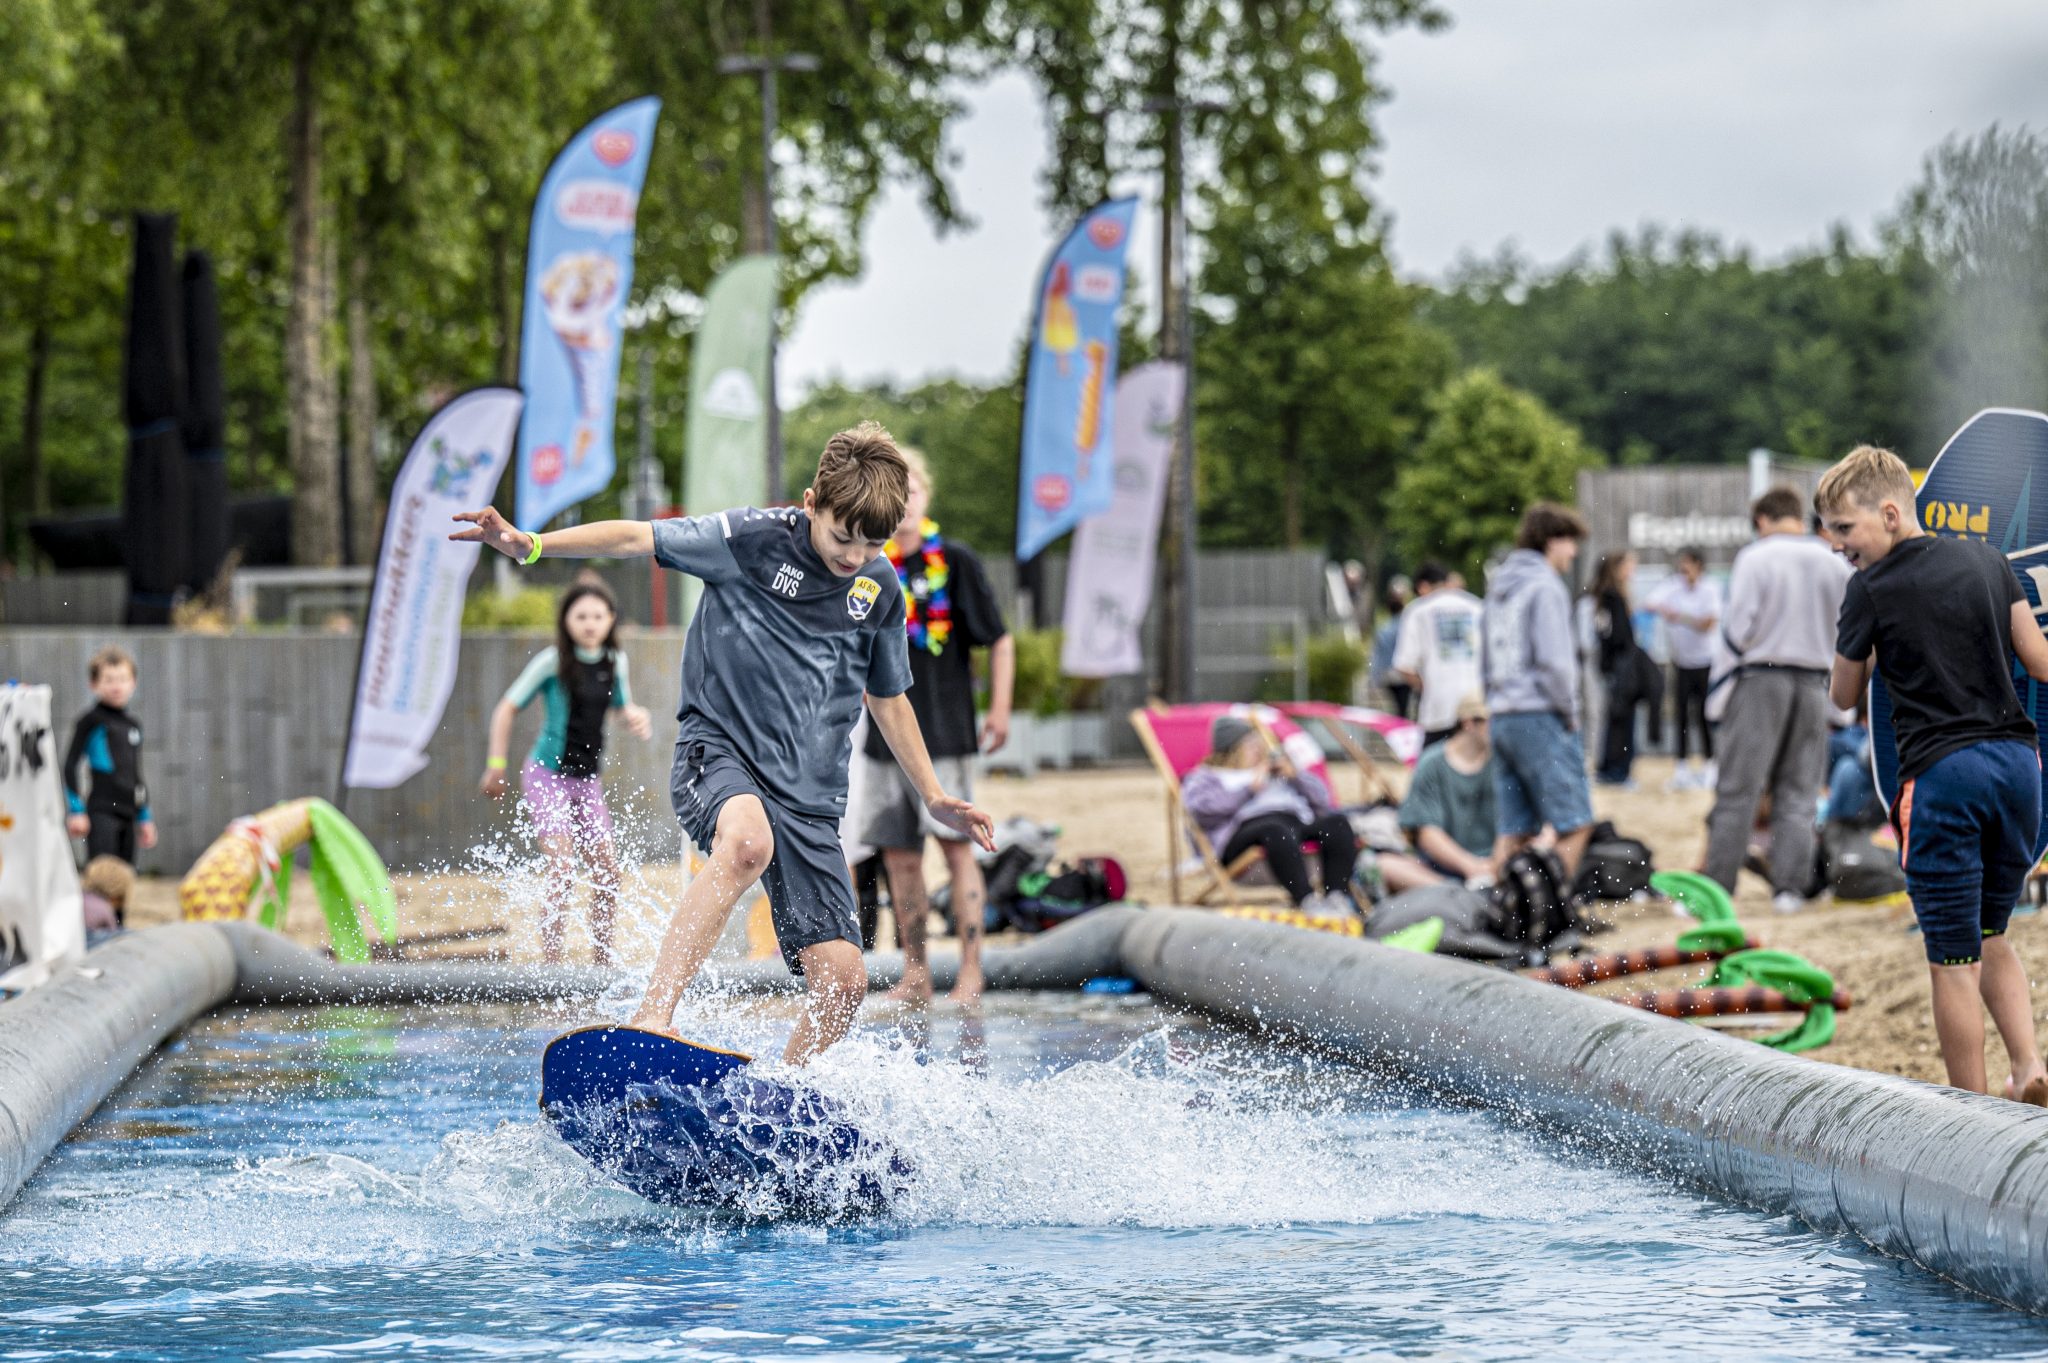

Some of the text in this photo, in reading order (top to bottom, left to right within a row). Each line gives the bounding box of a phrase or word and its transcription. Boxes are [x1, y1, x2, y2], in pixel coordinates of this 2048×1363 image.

[1925, 500, 1989, 533] PRO
[771, 571, 800, 598] DVS
[779, 562, 804, 581] JAKO
